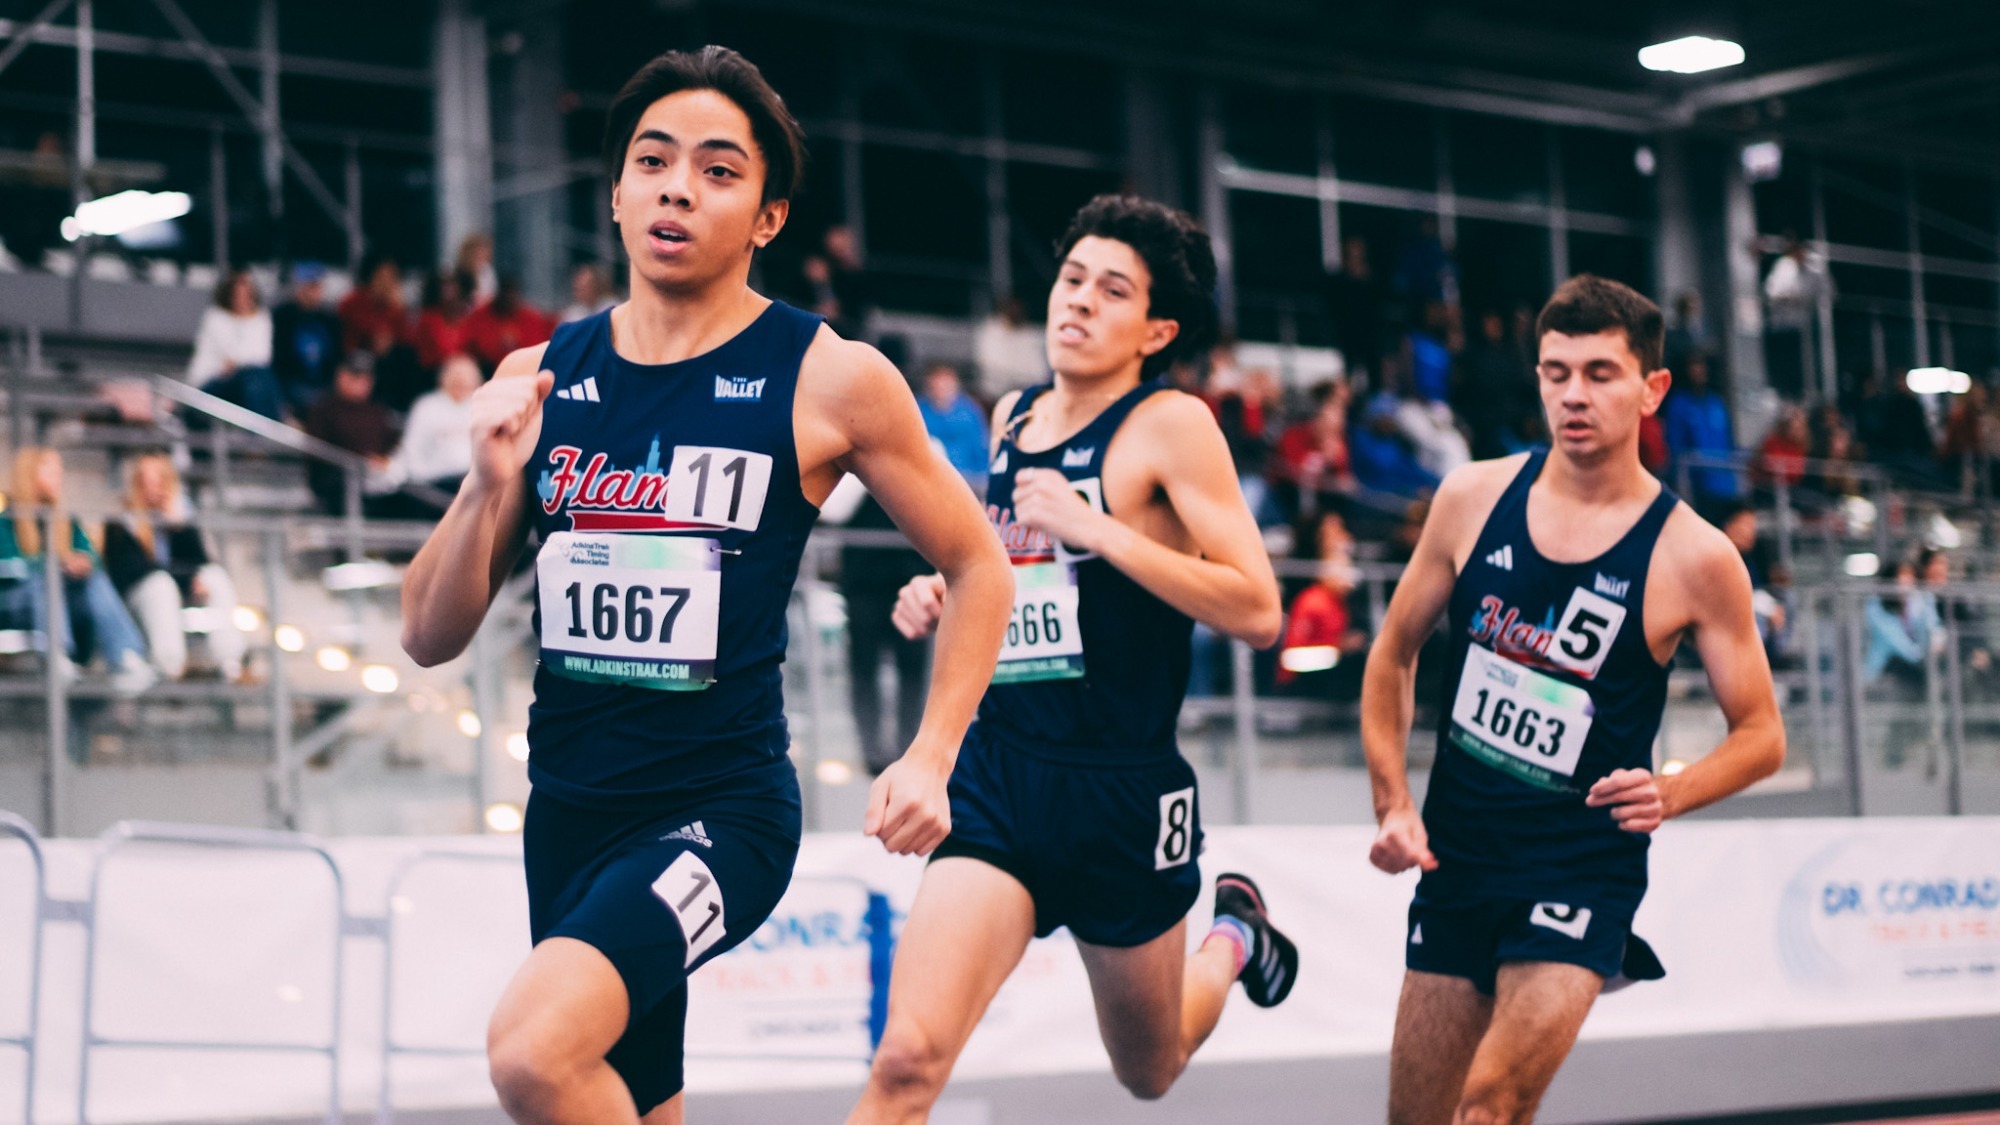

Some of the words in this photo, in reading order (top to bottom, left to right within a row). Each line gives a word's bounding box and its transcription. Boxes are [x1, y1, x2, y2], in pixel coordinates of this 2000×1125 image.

[715, 374, 767, 399] VALLEY
[543, 445, 670, 515] Flam
[688, 453, 747, 522] 11
[565, 582, 691, 643] 1667
[1002, 602, 1061, 647] 666
[1559, 608, 1610, 661] 5
[564, 656, 690, 679] WWW.ADKINSTRAK.COM
[1471, 688, 1566, 757] 1663
[1163, 798, 1187, 862] 8
[677, 870, 721, 945] 11
[1879, 877, 2000, 913] CONRAD
